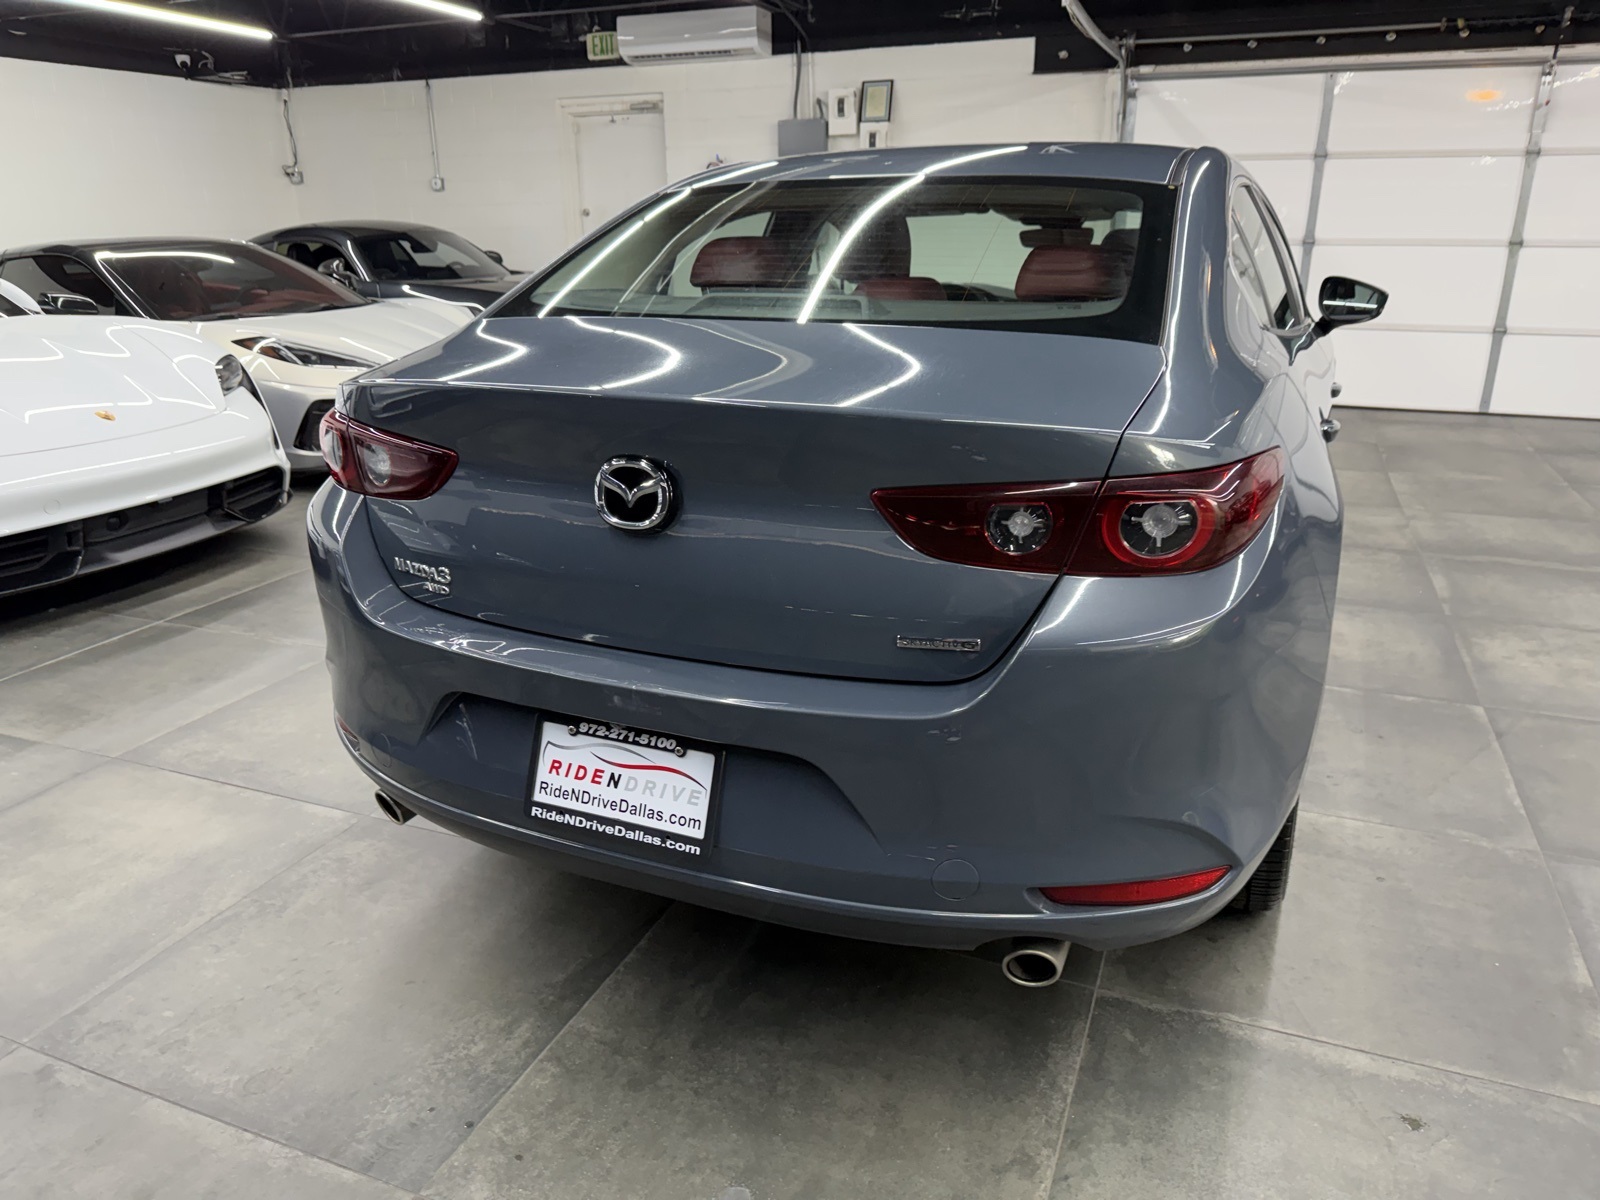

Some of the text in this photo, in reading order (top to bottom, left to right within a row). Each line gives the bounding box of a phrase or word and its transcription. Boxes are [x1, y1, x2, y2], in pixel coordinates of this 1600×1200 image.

[592, 33, 614, 57] EXIT
[394, 556, 452, 584] MAZDA3
[422, 582, 450, 595] AWD
[578, 722, 677, 750] 972-271-5100
[538, 780, 702, 830] RideNDriveDallas.com
[530, 806, 701, 855] RideNDriveDallas.com
